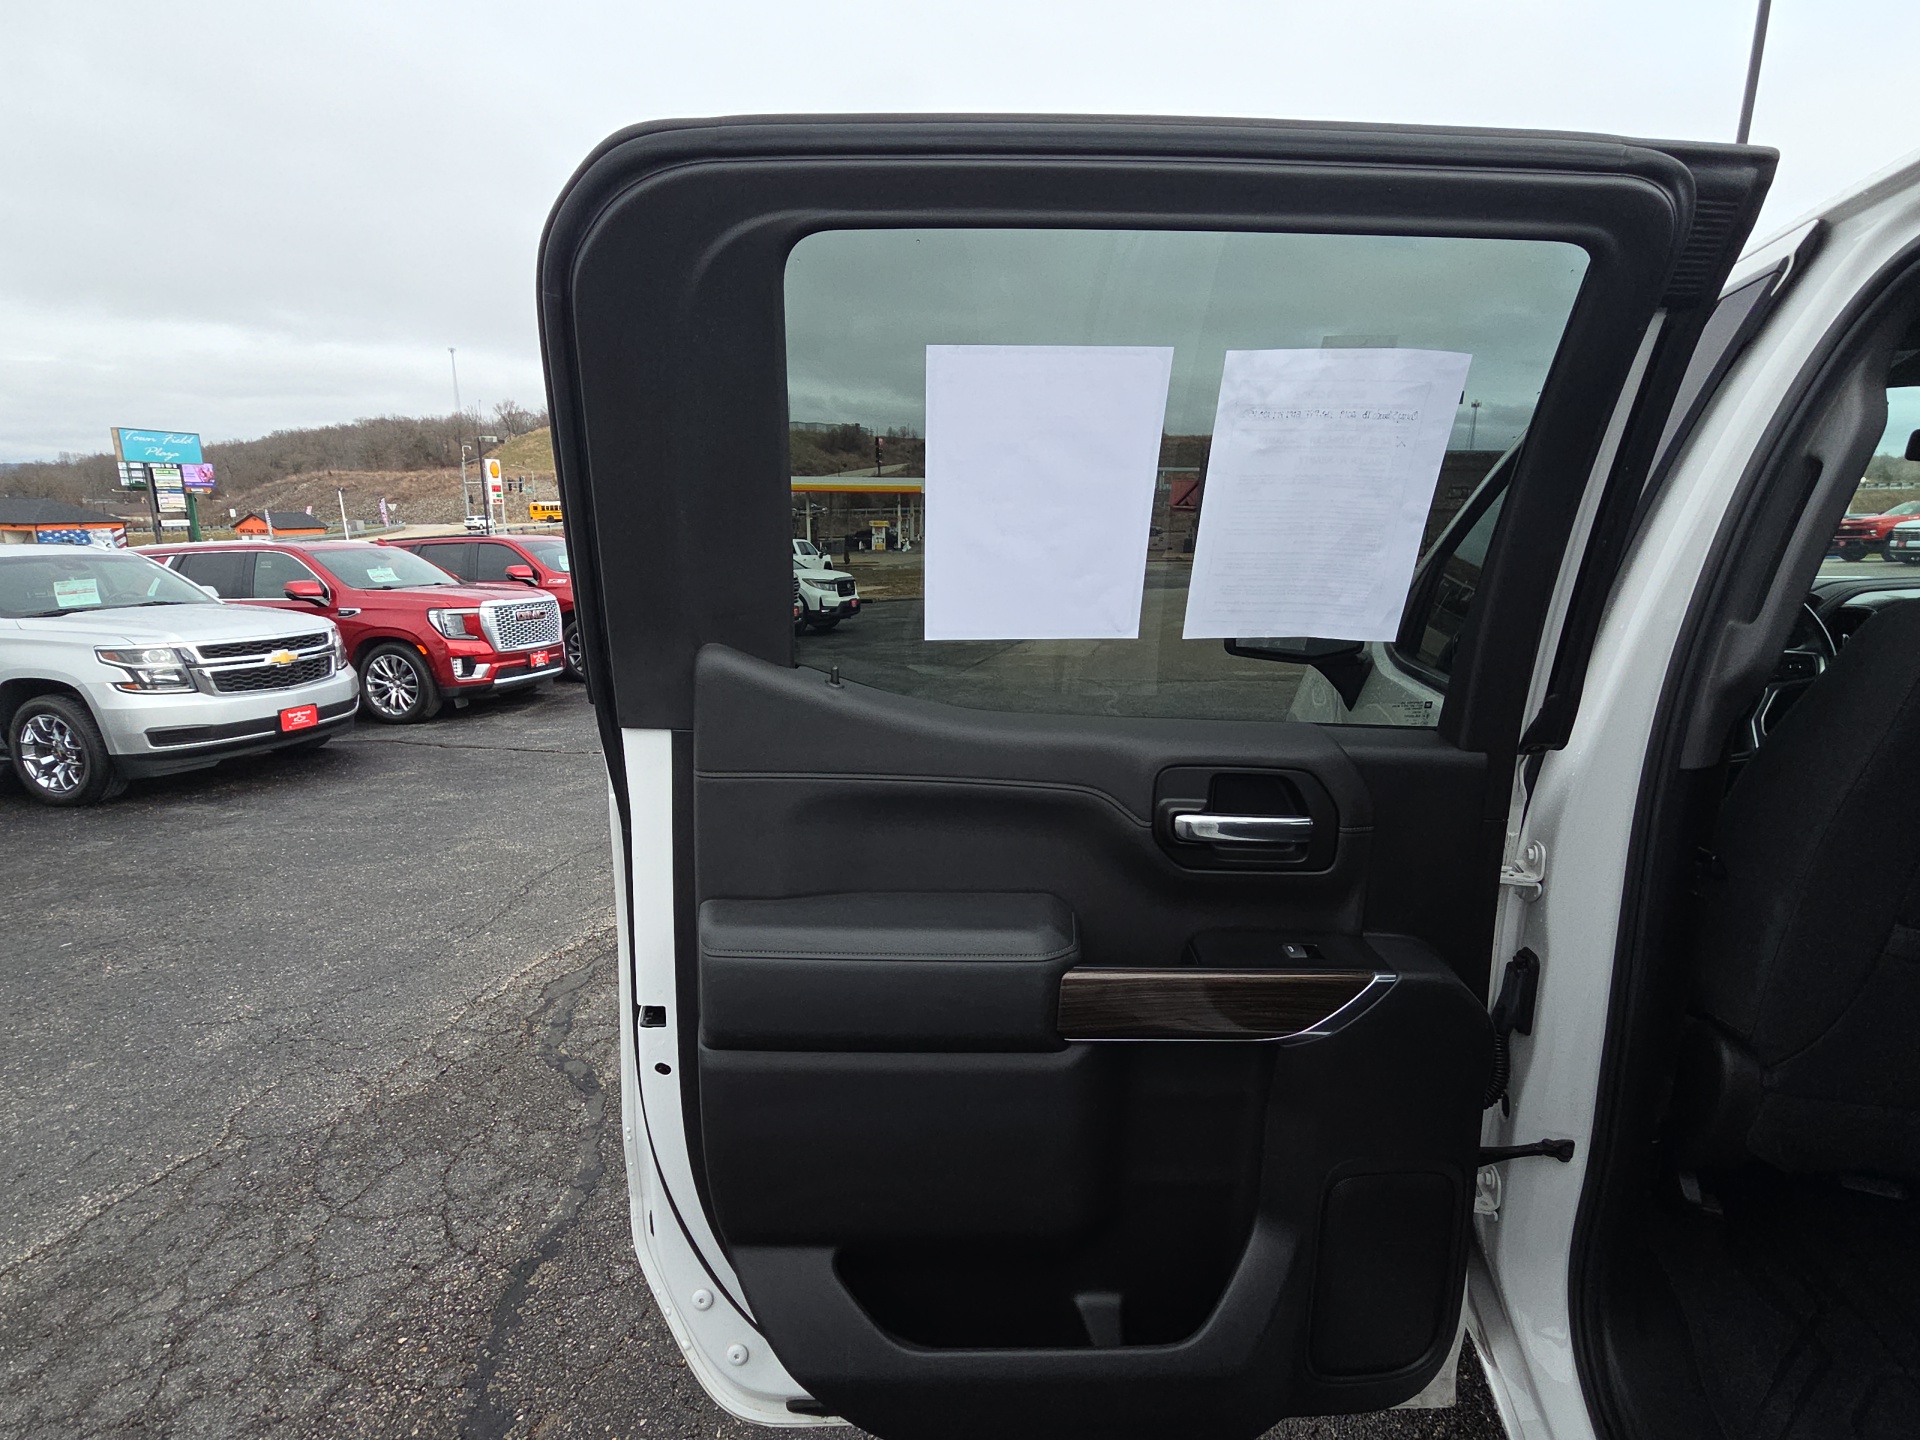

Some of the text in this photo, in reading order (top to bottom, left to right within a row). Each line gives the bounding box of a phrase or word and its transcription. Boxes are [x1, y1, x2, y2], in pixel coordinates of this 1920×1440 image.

[124, 430, 195, 445] Town Field
[145, 446, 180, 461] Plaza
